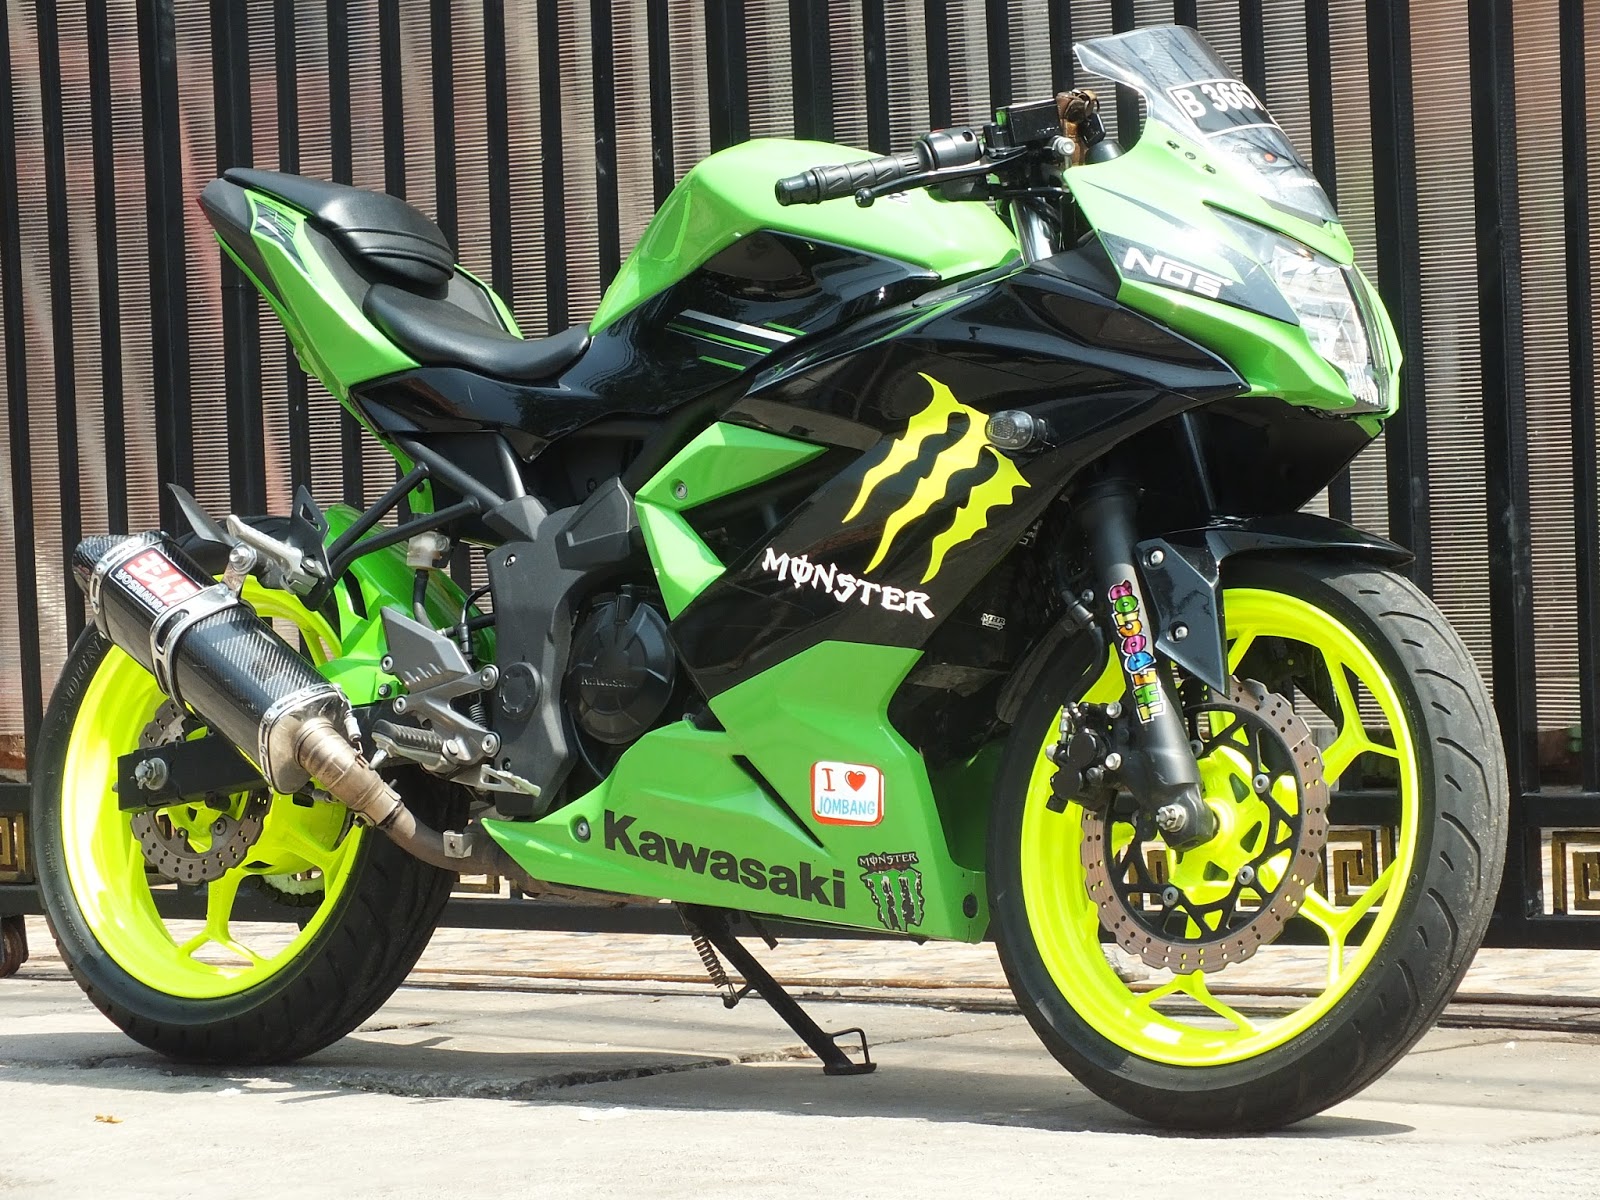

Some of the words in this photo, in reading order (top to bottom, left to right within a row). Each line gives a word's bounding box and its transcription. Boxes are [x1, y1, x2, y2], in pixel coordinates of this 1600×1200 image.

[1173, 89, 1206, 118] B
[1122, 247, 1233, 298] NOS
[1108, 579, 1157, 674] DOCTOR
[1130, 668, 1166, 724] THE
[821, 767, 837, 792] I
[817, 795, 876, 816] JOMBANG
[603, 808, 846, 909] Kawasaki
